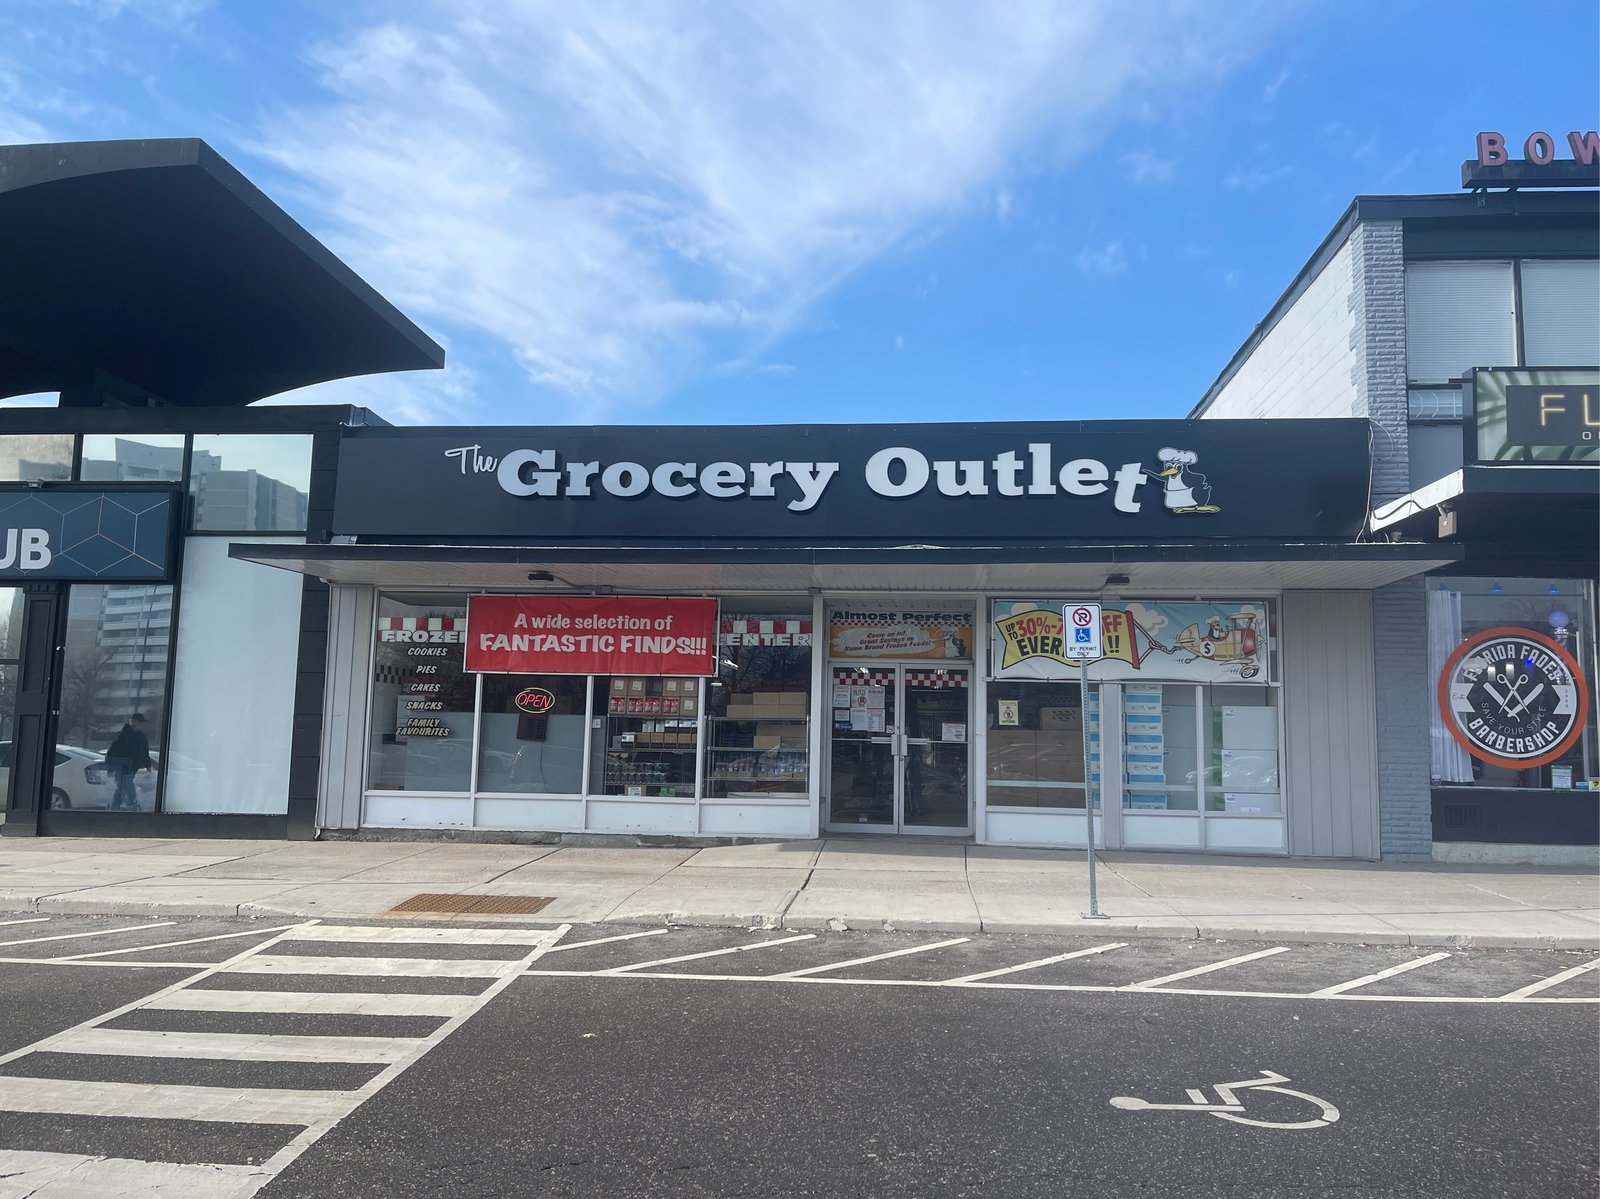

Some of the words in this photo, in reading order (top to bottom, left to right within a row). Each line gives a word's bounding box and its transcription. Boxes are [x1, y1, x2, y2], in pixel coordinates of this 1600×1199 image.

[1476, 132, 1600, 166] BOW
[1541, 394, 1600, 426] FL
[444, 444, 498, 474] The
[497, 449, 840, 511] Grocery
[865, 443, 1147, 513] Outlet
[514, 613, 528, 628] A
[532, 614, 570, 628] wide
[574, 614, 650, 631] selection
[654, 616, 673, 630] of
[832, 611, 897, 620] Almost
[902, 612, 971, 622] Perfect
[1006, 622, 1016, 632] UP
[1016, 616, 1064, 637] 30%-7
[1102, 614, 1122, 636] FF
[1008, 631, 1018, 640] TO
[480, 634, 615, 652] FANTASTIC
[620, 635, 706, 656] FINDS!!!
[408, 648, 448, 657] COOKIES
[416, 666, 438, 674] PIES
[1463, 644, 1516, 682] FRIDA
[1520, 646, 1562, 681] FADES
[410, 684, 441, 692] CAKES
[406, 702, 444, 710] SNACKS
[518, 694, 552, 708] OPEN
[407, 718, 441, 728] FAMILY
[1482, 702, 1496, 725] SAVE
[1498, 724, 1524, 735] YOUR
[1526, 706, 1546, 731] STYLE
[396, 728, 450, 737] FAVOURITES
[1468, 718, 1560, 752] BARBERSHOP
